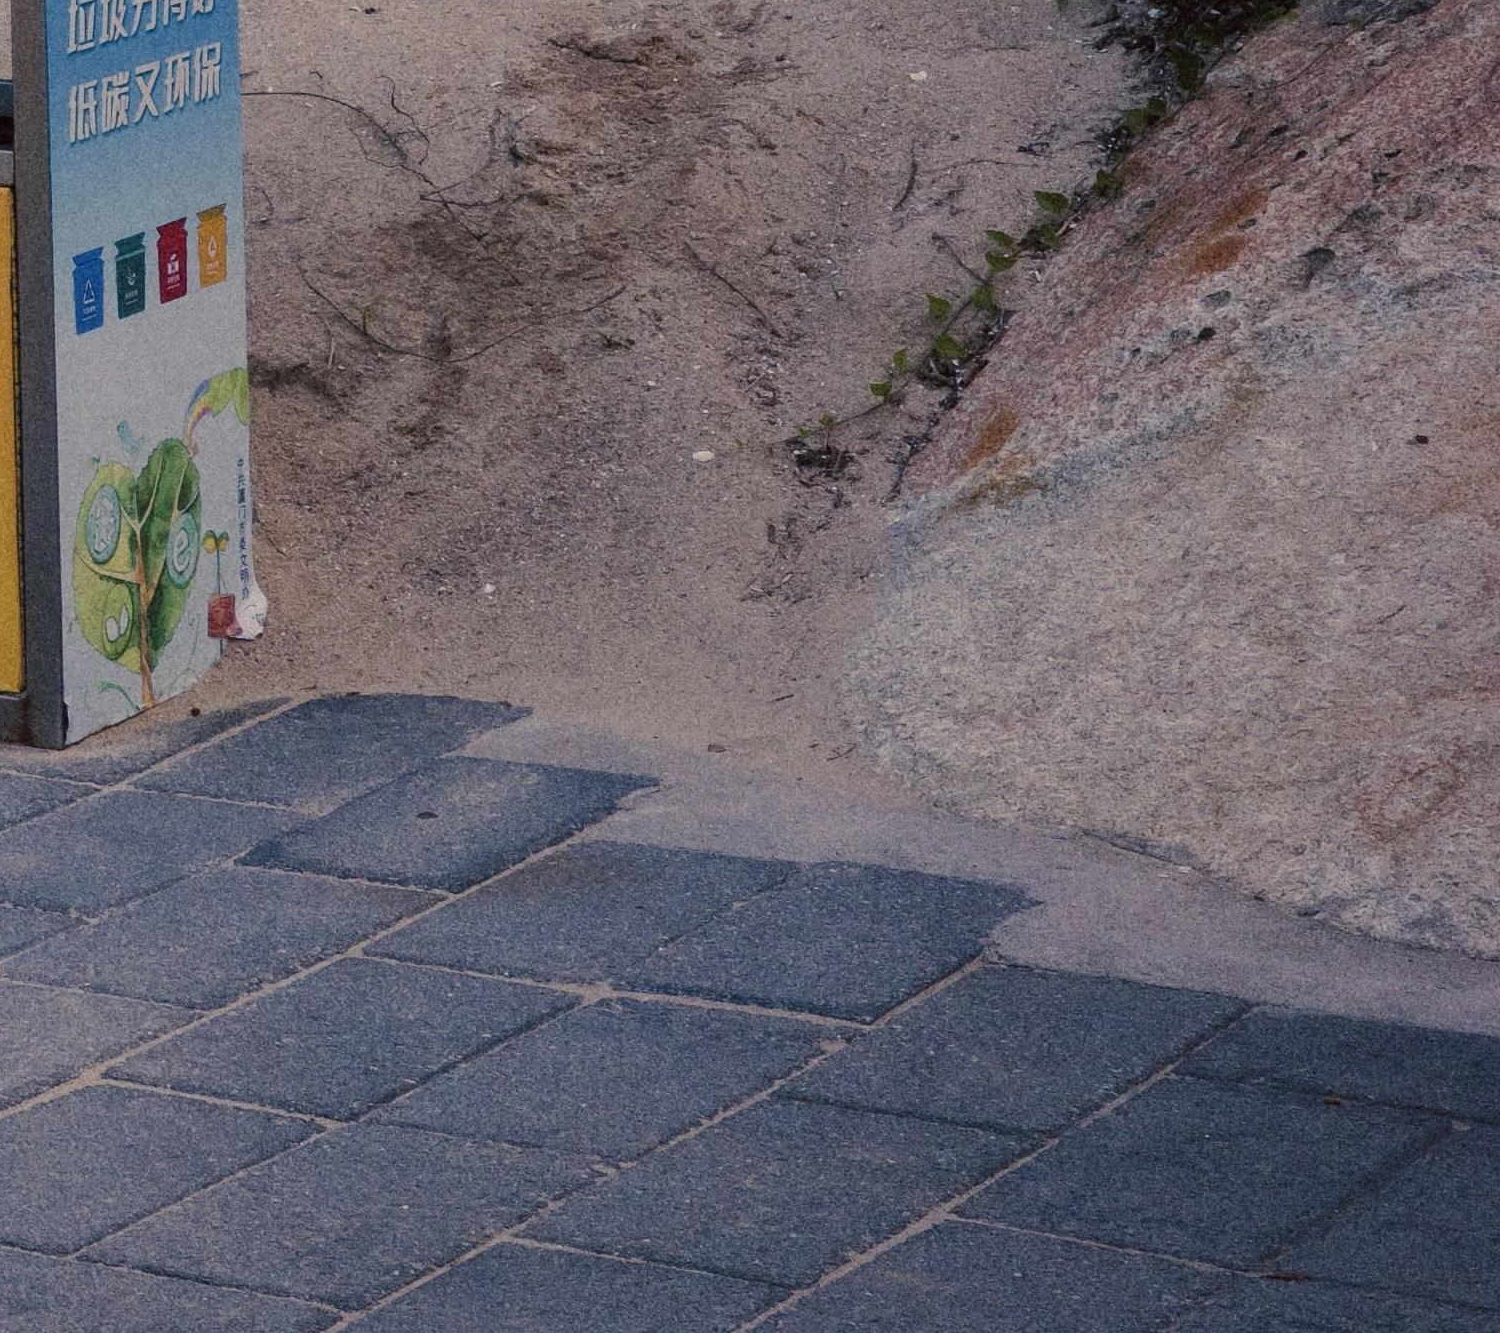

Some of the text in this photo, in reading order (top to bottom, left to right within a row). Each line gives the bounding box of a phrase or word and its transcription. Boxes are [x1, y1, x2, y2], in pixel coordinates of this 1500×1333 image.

[68, 40, 224, 145] 低碳又环保
